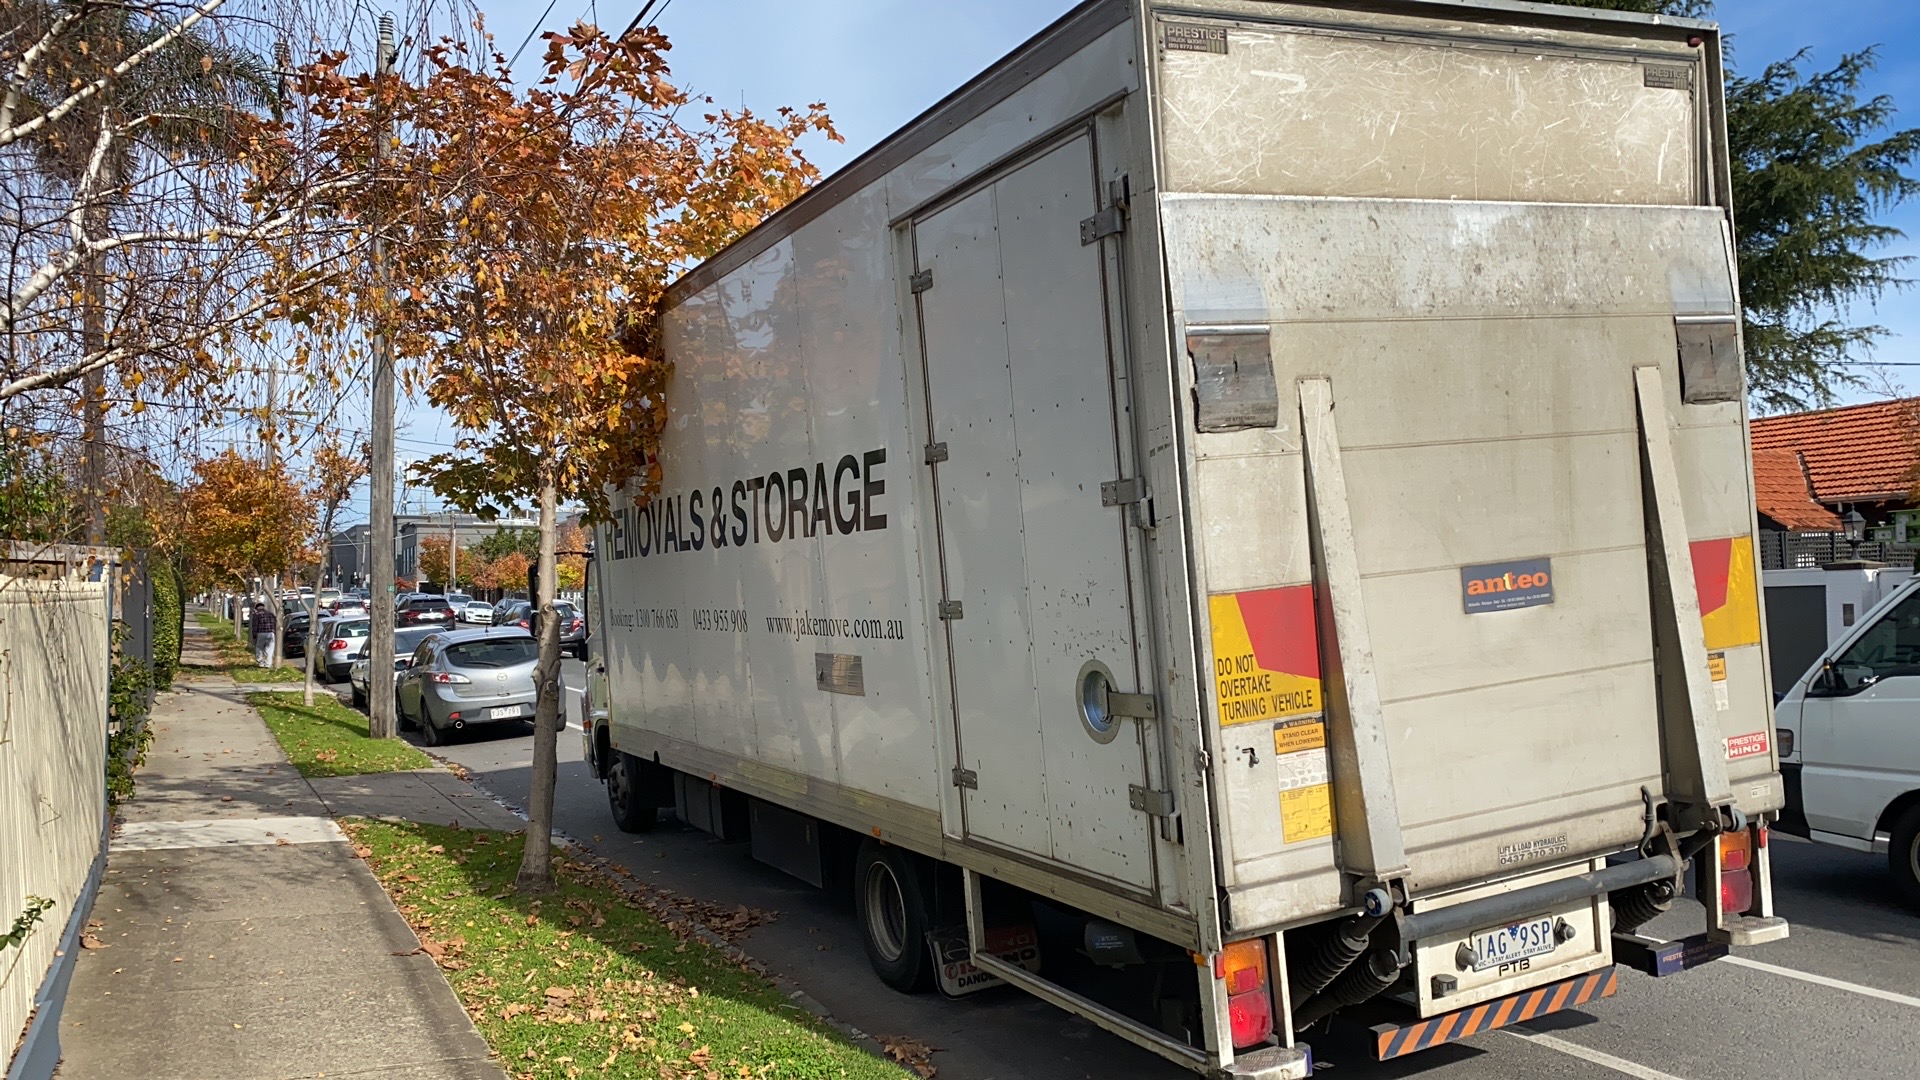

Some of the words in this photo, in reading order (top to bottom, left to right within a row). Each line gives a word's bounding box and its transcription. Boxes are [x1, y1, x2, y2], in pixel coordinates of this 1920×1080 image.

[1167, 26, 1225, 40] PRESTIGE
[1646, 67, 1687, 79] PRESTIGE
[605, 489, 704, 562] REMOVALS
[711, 486, 728, 549] &
[731, 447, 887, 547] STORAGE
[1467, 571, 1549, 596] anteo
[666, 609, 679, 629] 658
[693, 609, 711, 631] 0433
[714, 609, 729, 632] 955
[731, 609, 748, 633] 908
[766, 610, 904, 641] www.jakemove.com.au
[1217, 657, 1232, 677] DO
[1236, 654, 1254, 674] NOT
[1220, 674, 1271, 698] OVERTAKE
[1222, 696, 1266, 721] TURNING
[1271, 689, 1313, 714] VEHICLE
[1288, 717, 1317, 728] WARNING
[1279, 739, 1295, 748] WHEN
[1295, 736, 1324, 746] LOWERING
[1282, 731, 1300, 740] STAND
[1301, 728, 1319, 737] CLEAR
[1729, 732, 1766, 747] PRESTIGE
[1729, 743, 1761, 756] HINO
[1500, 845, 1511, 854] LIFT
[1518, 841, 1532, 851] LOAD
[1533, 835, 1566, 848] HYDRAULICS
[1500, 854, 1525, 865] 0437
[1527, 849, 1546, 860] 370
[1549, 845, 1567, 855] 370
[1477, 931, 1507, 961] 1AG
[1520, 920, 1550, 949] 9SP
[1492, 956, 1504, 964] STAY
[1505, 951, 1520, 960] ALERT
[1523, 947, 1536, 956] STAY
